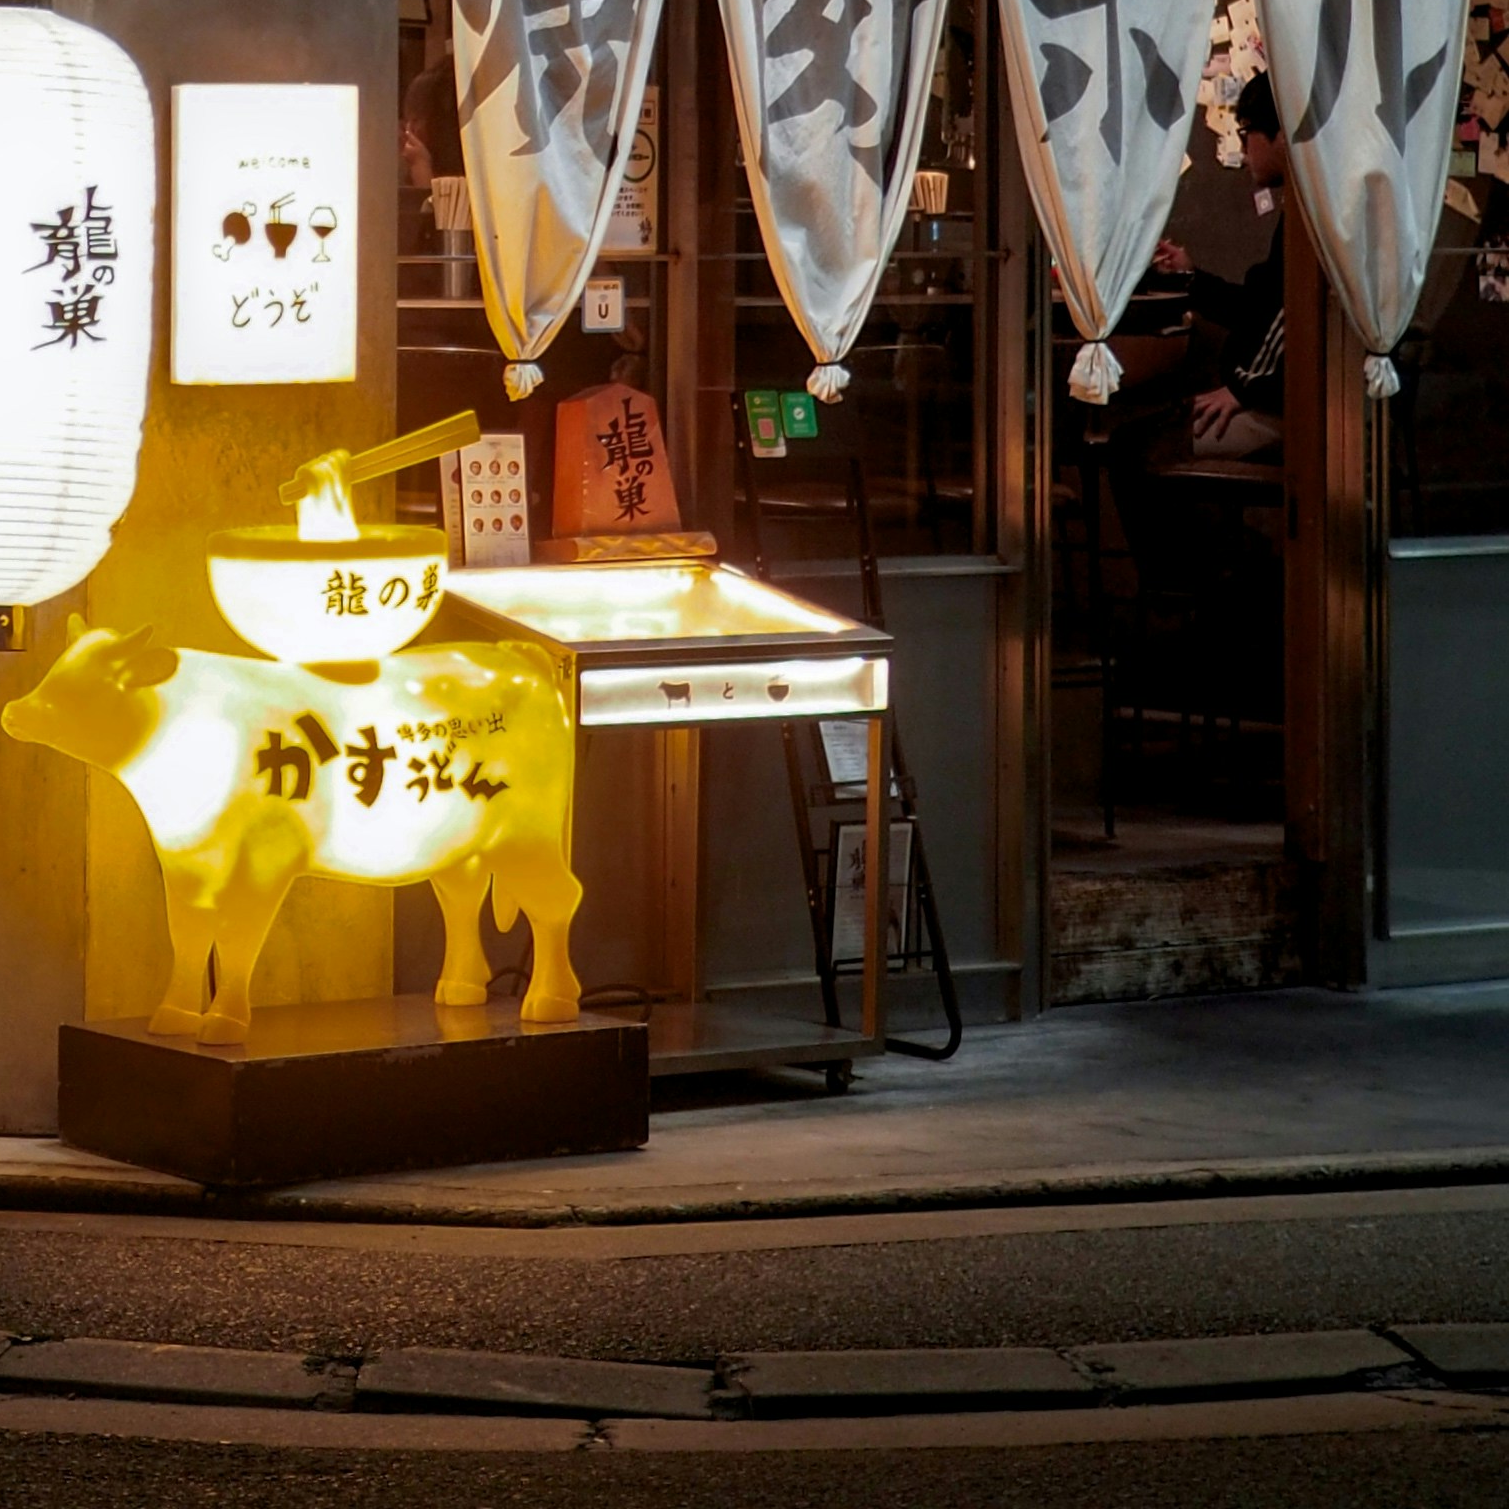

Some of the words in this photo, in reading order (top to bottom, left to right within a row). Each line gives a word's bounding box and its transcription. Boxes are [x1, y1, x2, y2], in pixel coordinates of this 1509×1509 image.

[22, 185, 119, 351] 龍の巣
[231, 282, 319, 328] どうぞ
[596, 396, 654, 522] 龍の巣
[321, 564, 439, 616] 龍の巣
